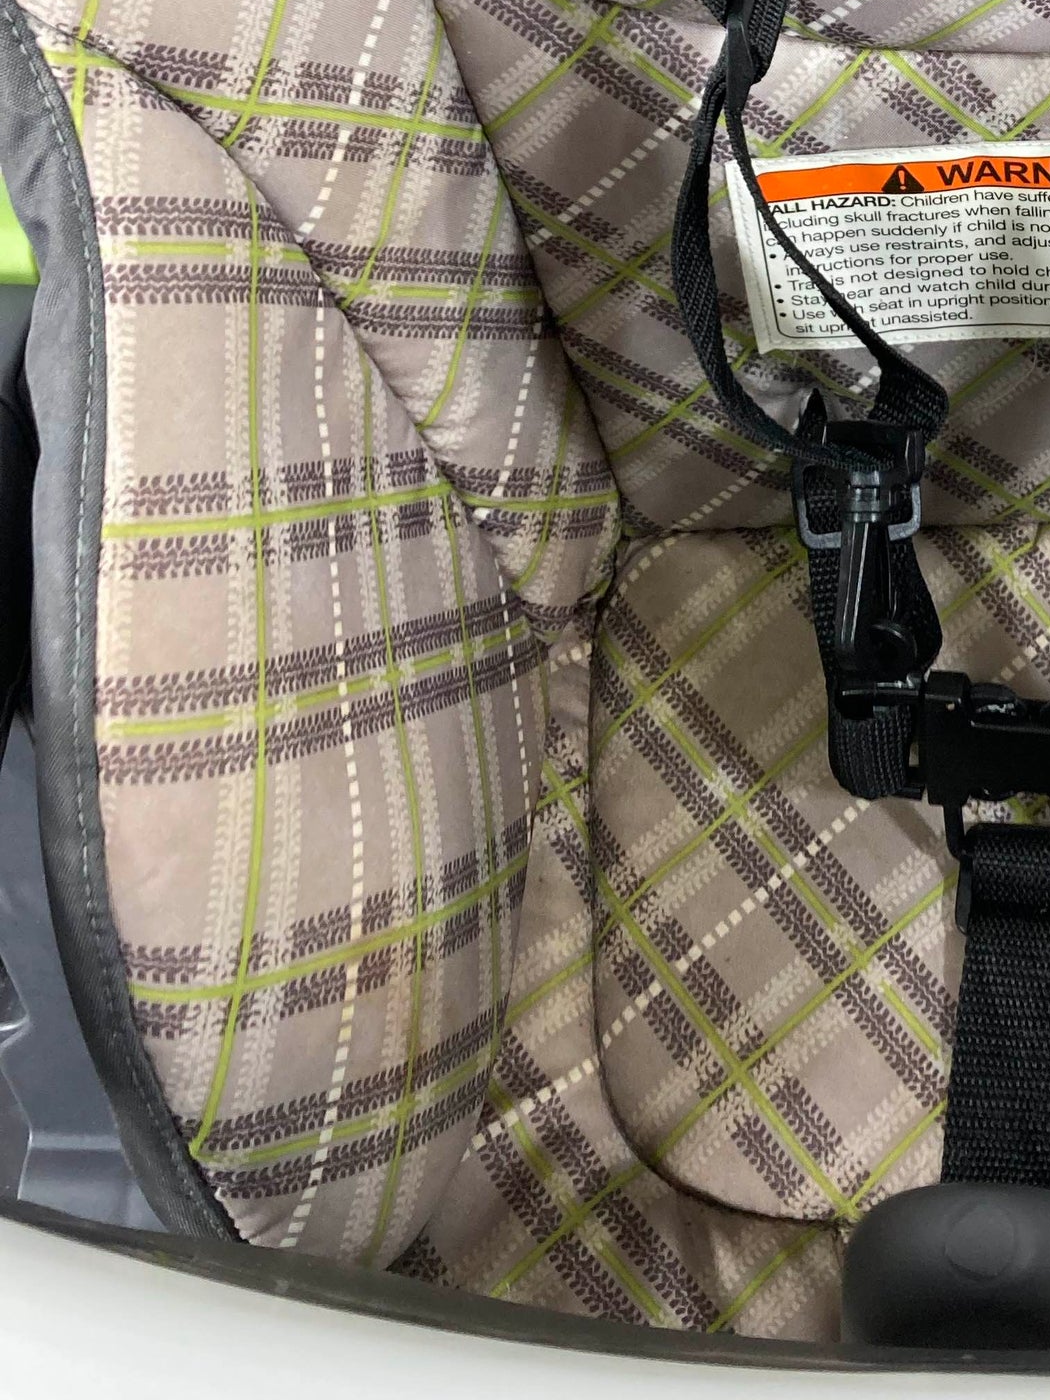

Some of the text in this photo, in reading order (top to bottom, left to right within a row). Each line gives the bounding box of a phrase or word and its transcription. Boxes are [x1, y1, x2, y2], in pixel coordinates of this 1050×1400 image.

[767, 202, 807, 215] ALL
[811, 195, 896, 211] HAZARD:
[900, 194, 969, 207] Children
[974, 190, 1013, 201] have
[844, 211, 881, 222] skull
[887, 209, 960, 221] fractures
[965, 204, 1010, 216] when
[802, 229, 866, 242] happen
[871, 224, 947, 237] suddenly
[953, 221, 962, 233] if
[967, 219, 1006, 231] child
[1012, 220, 1025, 231] is
[850, 242, 880, 252] use
[886, 238, 968, 250] restraints,
[974, 234, 1006, 246] and
[786, 251, 1013, 276] inructions for proper use.
[850, 271, 878, 283] not
[884, 266, 963, 280] designed
[970, 266, 986, 275] to
[992, 264, 1029, 276] hold
[879, 283, 911, 295] and
[917, 280, 969, 292] watch
[975, 279, 1016, 290] child
[793, 309, 825, 320] Use
[869, 298, 904, 312] seat
[908, 297, 922, 308] in
[927, 294, 984, 308] upright
[795, 323, 814, 333] sit
[881, 309, 973, 325] unassisted.
